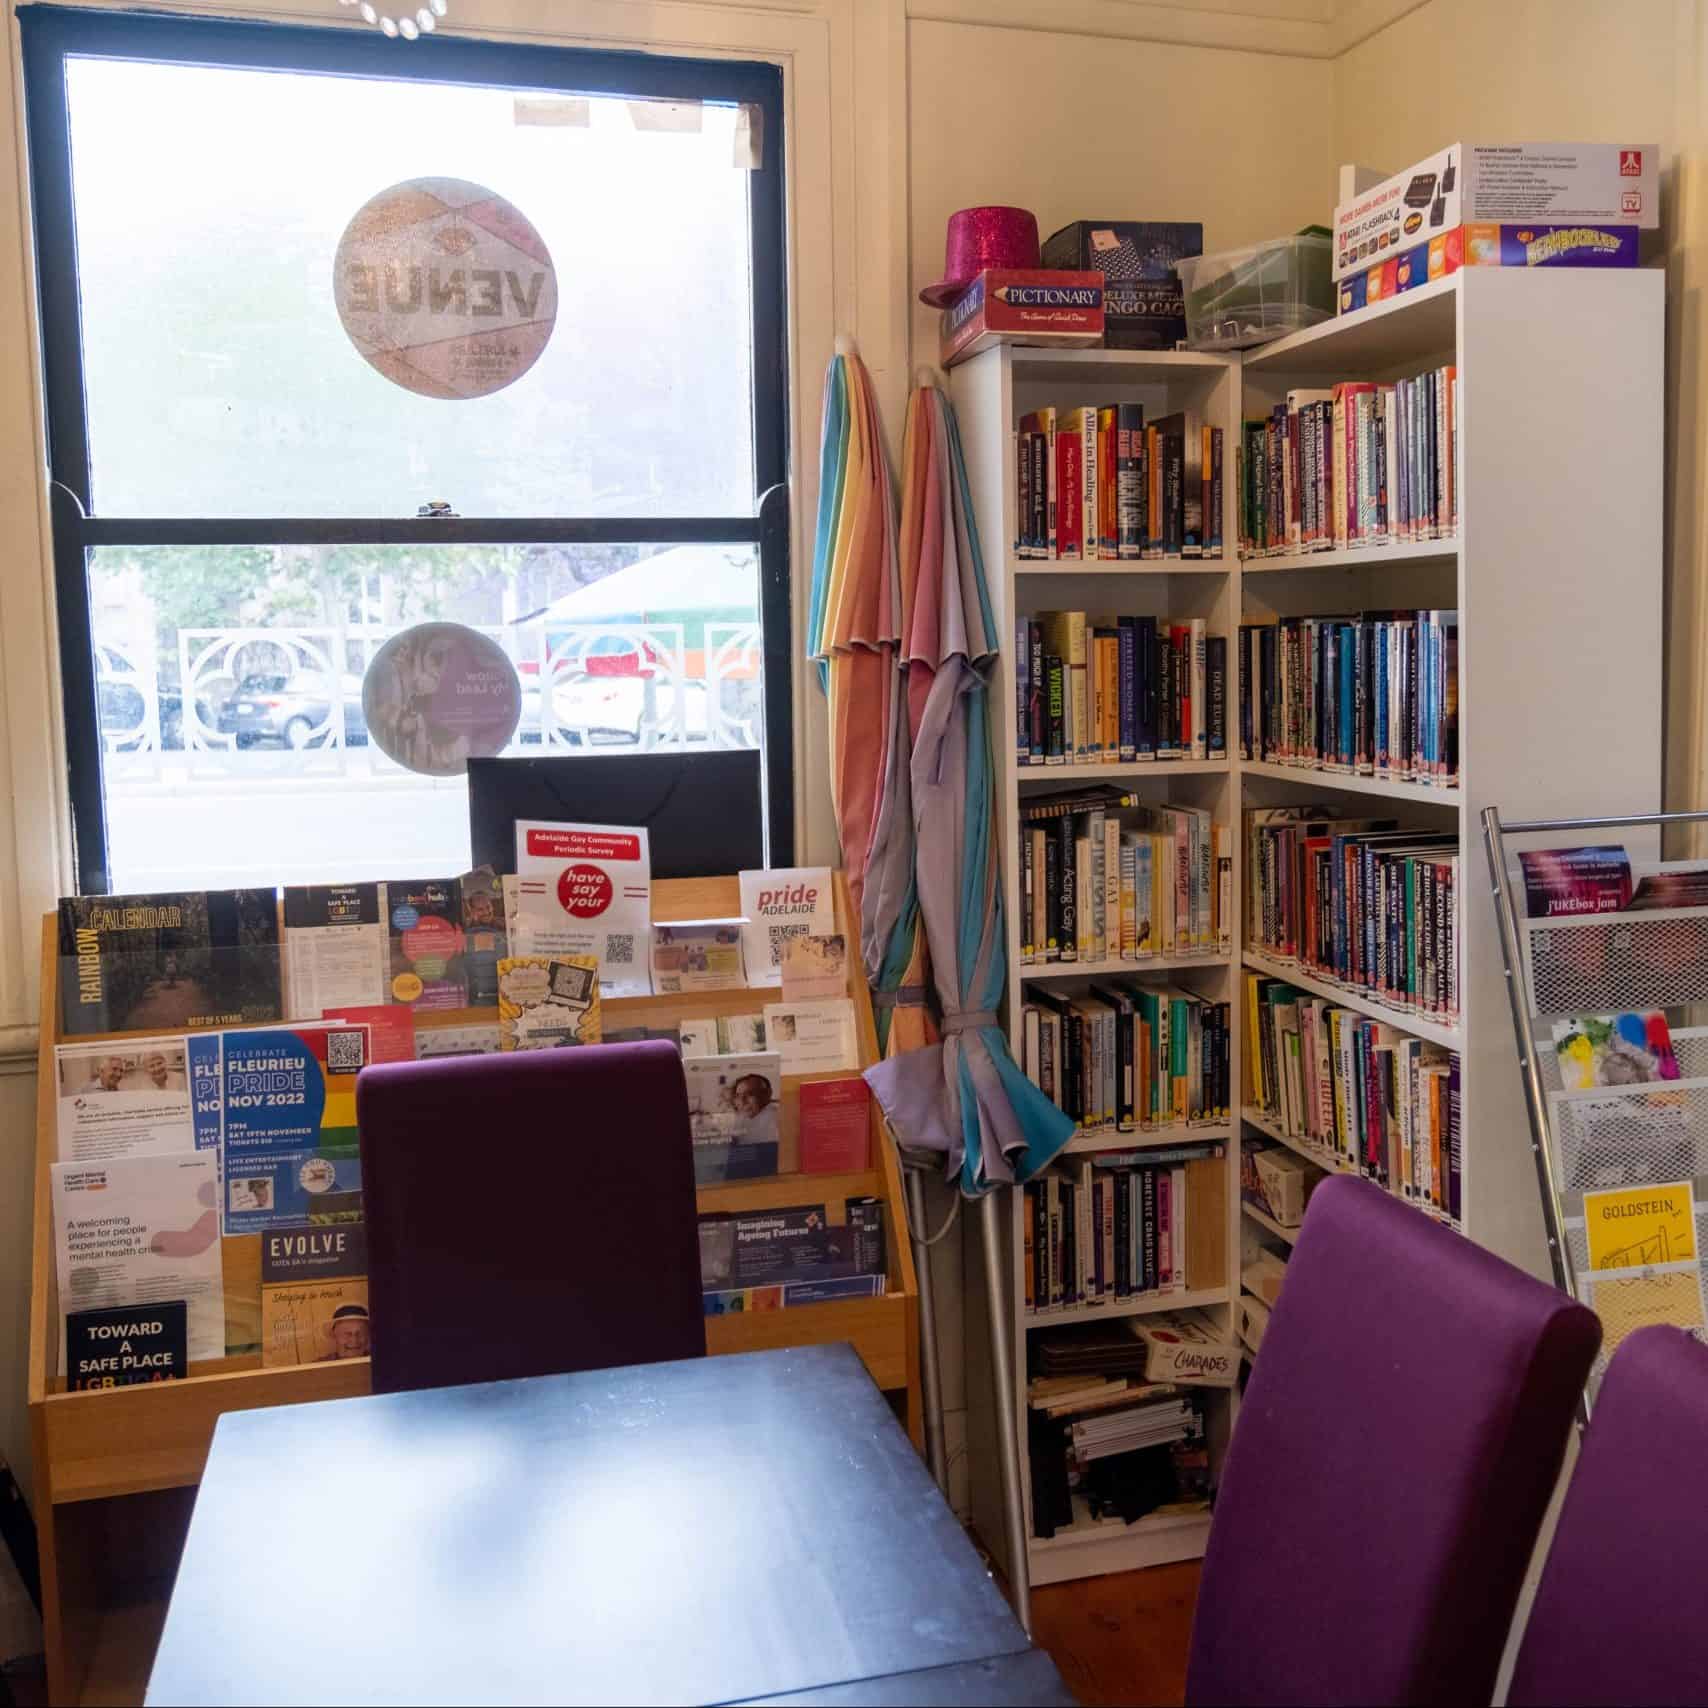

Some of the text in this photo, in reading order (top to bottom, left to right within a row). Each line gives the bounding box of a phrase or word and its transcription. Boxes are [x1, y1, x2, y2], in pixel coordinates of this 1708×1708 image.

[1624, 199, 1638, 209] TV
[1393, 208, 1400, 221] 4
[1010, 288, 1095, 305] PICTIONARY
[1104, 300, 1184, 315] INGO CAG
[1085, 410, 1096, 443] Allies
[1086, 446, 1096, 457] in
[1316, 436, 1325, 481] SILENCE
[1084, 458, 1096, 503] Healing
[1118, 470, 1142, 529] BACKLASH
[1032, 642, 1041, 656] TOO
[1032, 657, 1041, 676] MUCH
[1160, 644, 1170, 701] Dorothy Porter
[1049, 667, 1062, 718] WICKED
[1213, 670, 1223, 737] DEAD EUROP
[534, 833, 632, 847] Adelaide Gay Community
[554, 845, 614, 856] Periodic Survey
[566, 869, 606, 884] have
[1060, 867, 1075, 904] Acting
[572, 884, 600, 897] say
[757, 884, 818, 911] pride
[1107, 875, 1118, 906] GAY
[1423, 877, 1431, 909] HOUSE
[566, 897, 604, 910] your
[762, 903, 816, 916] ADELAIDE
[1435, 882, 1445, 927] SECOND
[1595, 896, 1617, 913] jam
[90, 906, 182, 930] CALENDAR
[1061, 905, 1076, 932] Gay
[1423, 919, 1431, 958] CLOUDS
[1435, 927, 1446, 971] SEASON
[76, 928, 103, 1005] RAINBOW
[221, 1014, 243, 1024] YEARS
[228, 1048, 288, 1058] CELEBRATE
[228, 1057, 305, 1073] FLEURIEU
[228, 1072, 305, 1094] PRIDE
[228, 1093, 305, 1108] NOV 2022
[1320, 1079, 1334, 1128] QUEER
[229, 1131, 244, 1139] SAT
[268, 1127, 312, 1136] NOVEMBER
[1602, 1200, 1673, 1220] GOLDSTEIN
[67, 1215, 131, 1229] A welcoming
[736, 1218, 785, 1231] Imagining
[1144, 1171, 1153, 1273] HONEYBEE CRAIG SILVE
[68, 1225, 147, 1241] place for people
[738, 1230, 771, 1242] Ageing
[68, 1237, 142, 1251] experiencing a
[69, 1249, 104, 1261] mental
[105, 1246, 137, 1258] health
[271, 1233, 346, 1257] EVOLVE
[87, 1321, 163, 1340] TOWARD
[119, 1340, 132, 1353] A
[79, 1352, 173, 1373] SAFE PLACE
[1174, 1350, 1229, 1372] CHARADES
